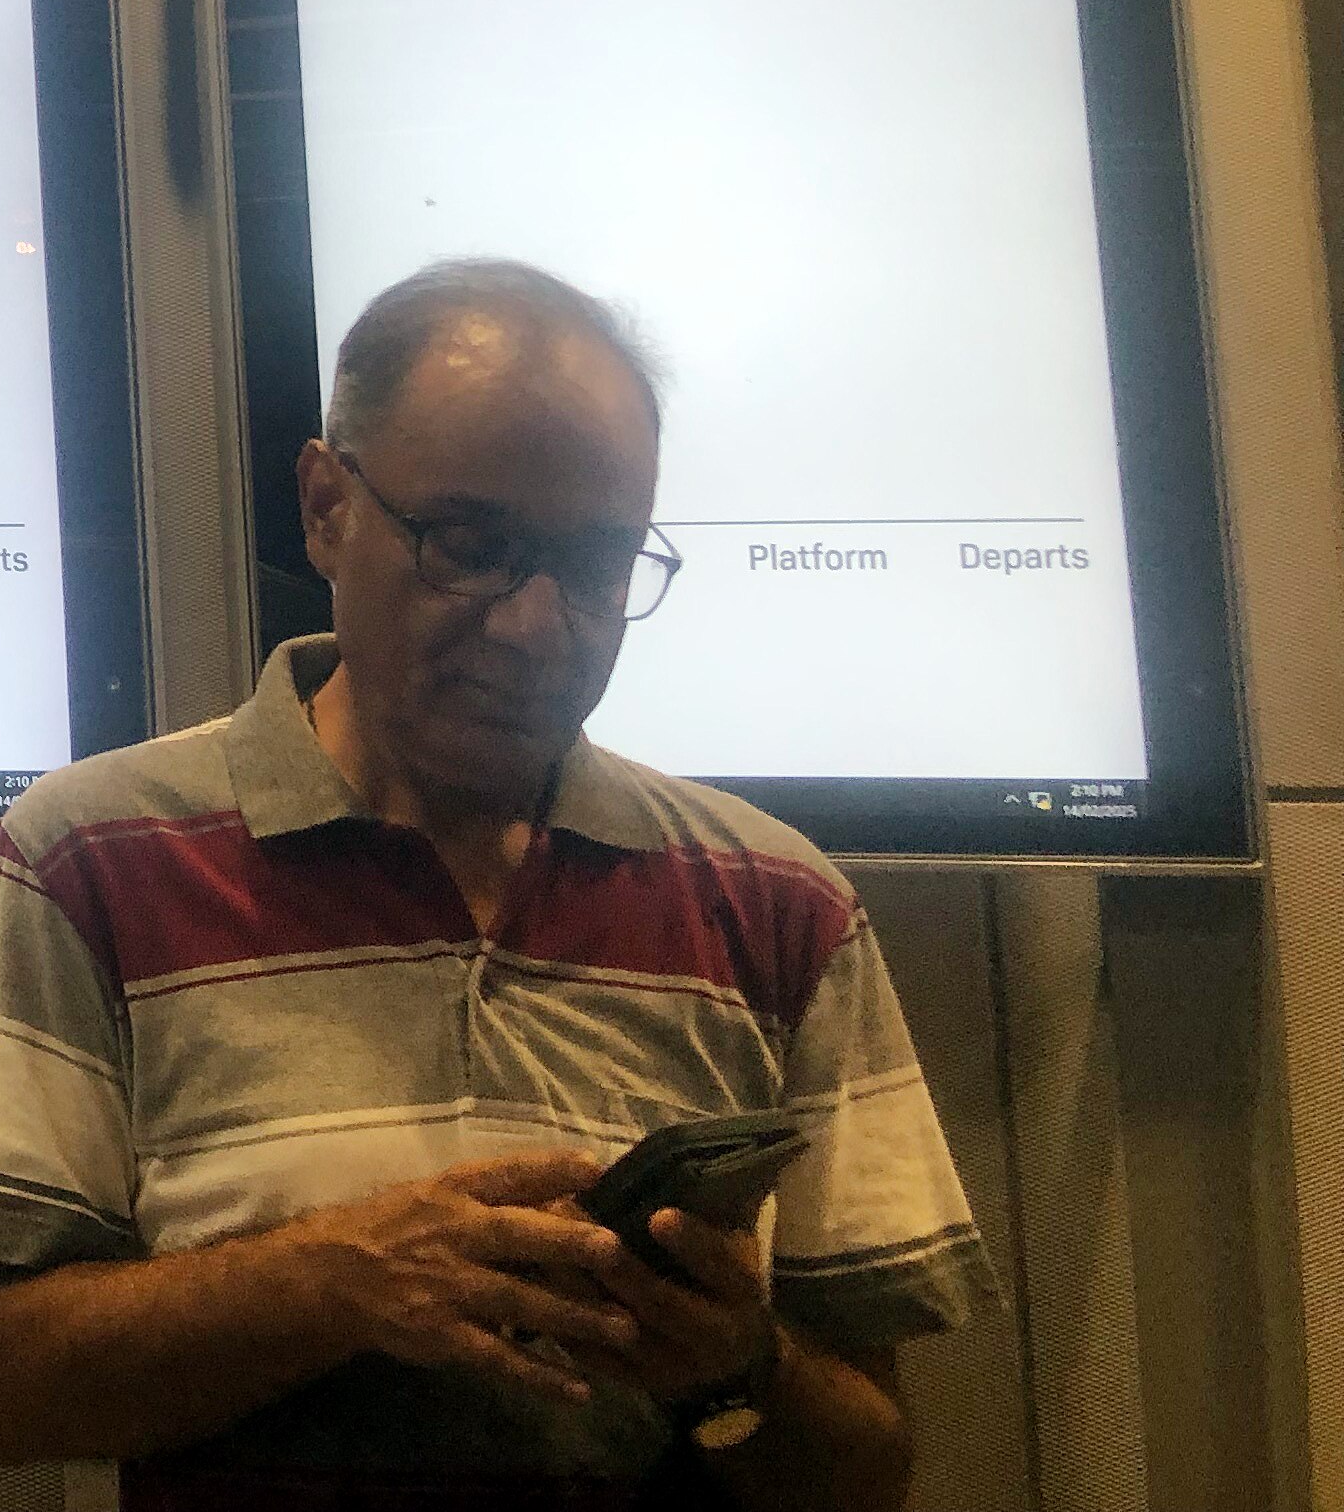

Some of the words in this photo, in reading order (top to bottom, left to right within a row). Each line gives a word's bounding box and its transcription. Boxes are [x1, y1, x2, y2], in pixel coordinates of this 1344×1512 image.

[748, 542, 888, 571] Platform
[958, 543, 1090, 576] Departs
[4, 775, 30, 789] 2:10
